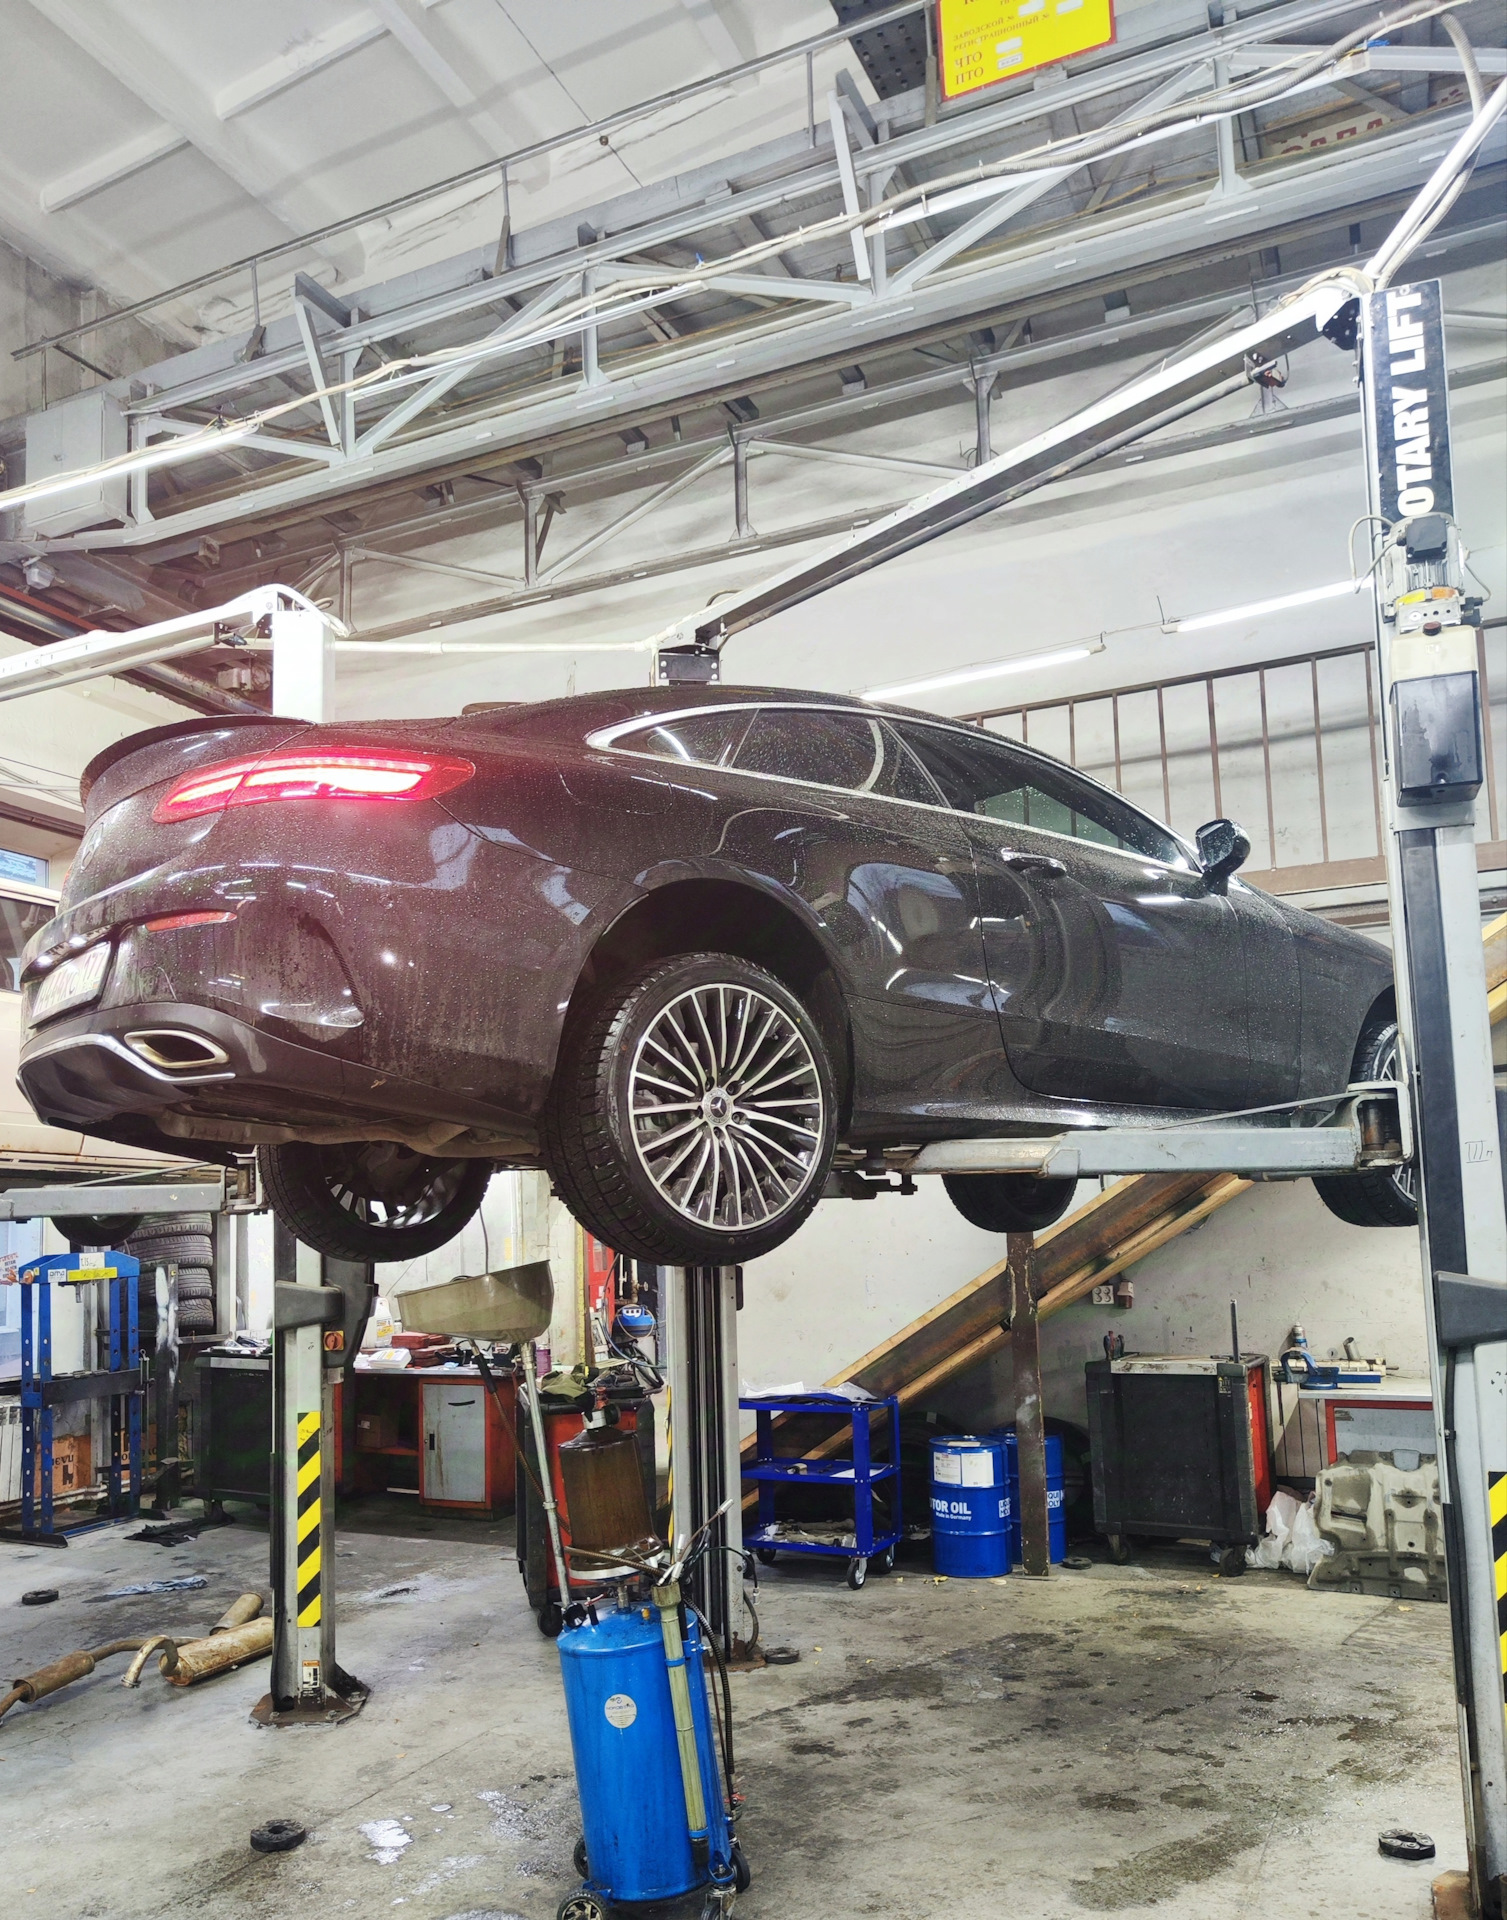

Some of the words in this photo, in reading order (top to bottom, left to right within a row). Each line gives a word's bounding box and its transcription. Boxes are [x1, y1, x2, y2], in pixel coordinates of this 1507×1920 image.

[953, 15, 1039, 51] РЕГИСТРАЦИОННЫЙ
[954, 18, 1003, 40] ЗАВОДСКОЙ
[955, 51, 983, 68] ЧТО
[956, 66, 984, 85] ПТО
[1386, 291, 1426, 376] LIFT
[1391, 386, 1435, 517] OTARY
[930, 1497, 949, 1513] TOR
[950, 1501, 972, 1514] OIL
[1047, 1492, 1059, 1500] QUI
[950, 1513, 972, 1521] Germany
